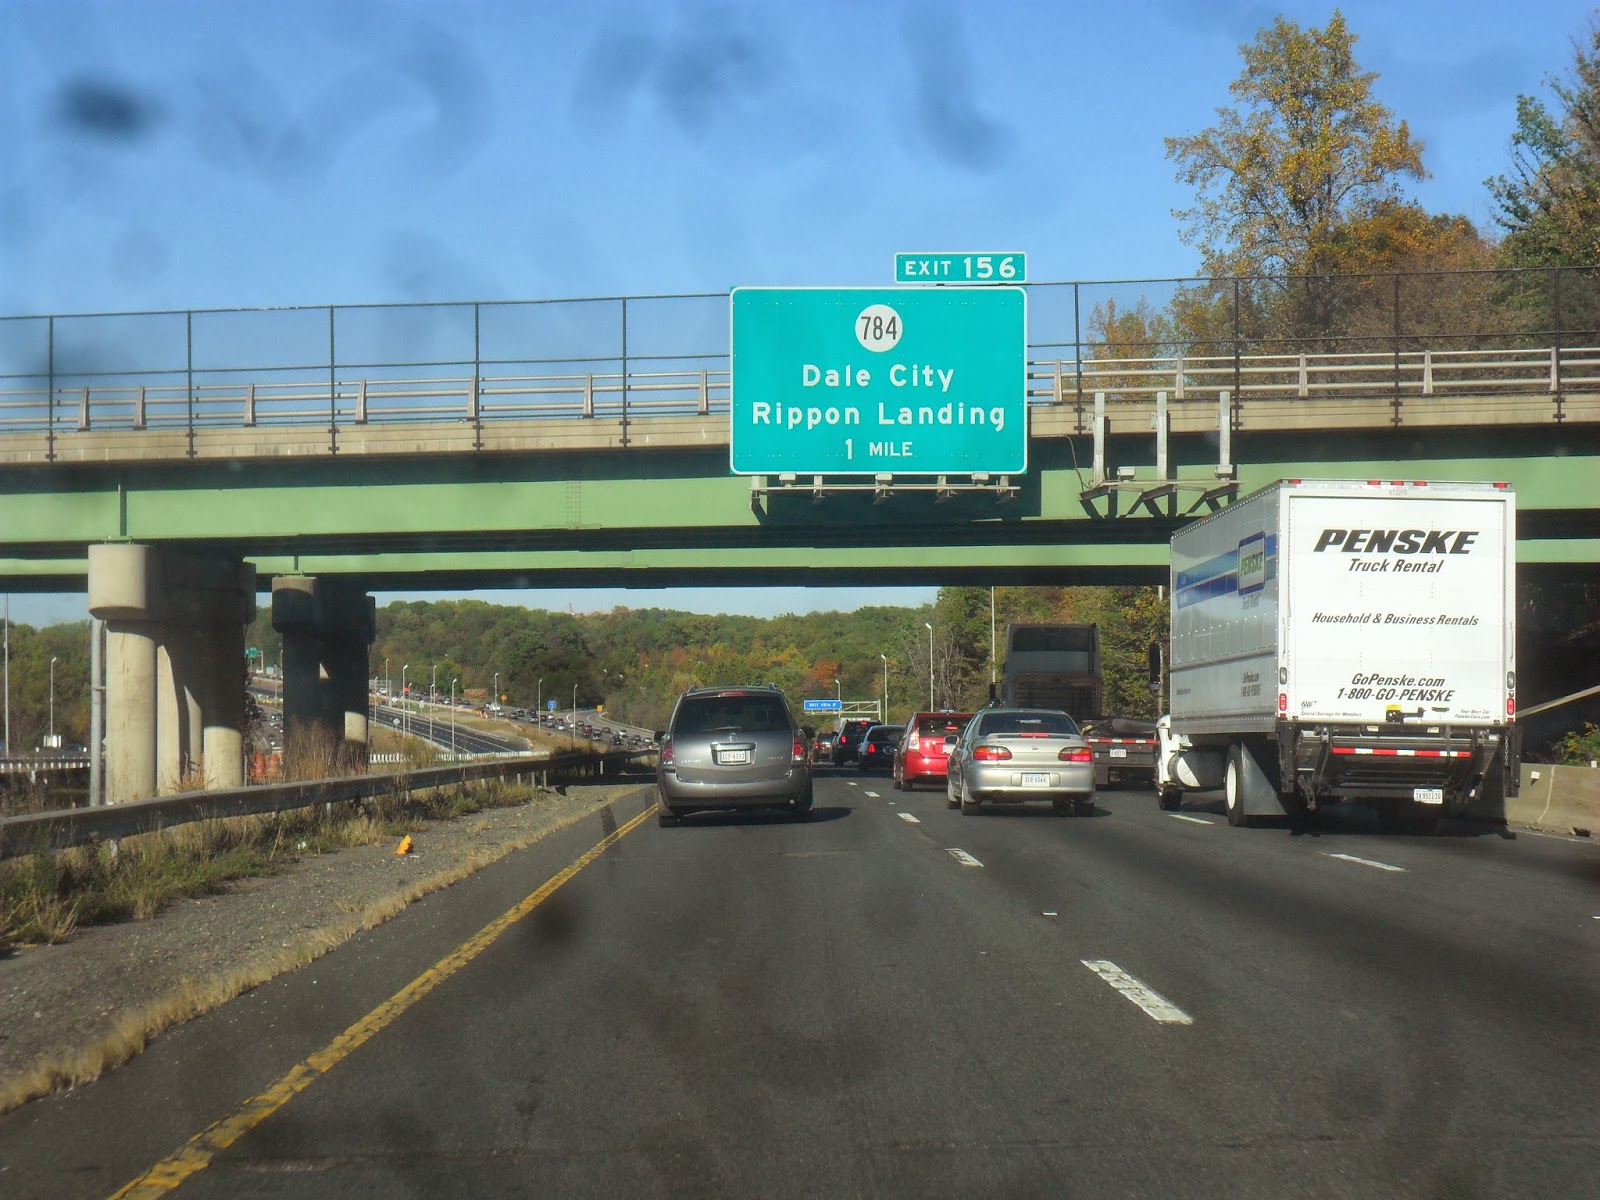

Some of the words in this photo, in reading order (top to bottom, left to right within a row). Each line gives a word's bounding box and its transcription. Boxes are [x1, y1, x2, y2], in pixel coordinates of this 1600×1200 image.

[905, 260, 951, 276] EXIT
[963, 257, 1016, 278] 156
[860, 315, 898, 341] 784
[802, 364, 871, 387] Dale
[889, 364, 955, 392] City
[752, 402, 860, 431] Rippon
[878, 402, 1006, 432] Landing
[845, 438, 853, 460] 1
[869, 441, 913, 457] MILE
[1313, 529, 1480, 555] PENSKE
[1348, 558, 1391, 573] Truck
[1392, 559, 1445, 573] Rental
[1311, 612, 1372, 625] Household
[1372, 613, 1383, 625] &
[1384, 613, 1436, 626] Business
[1436, 614, 1480, 627] Rentals
[1351, 673, 1446, 688] GoPenske.com
[1336, 687, 1456, 702] 1-800-GO-PENSKE
